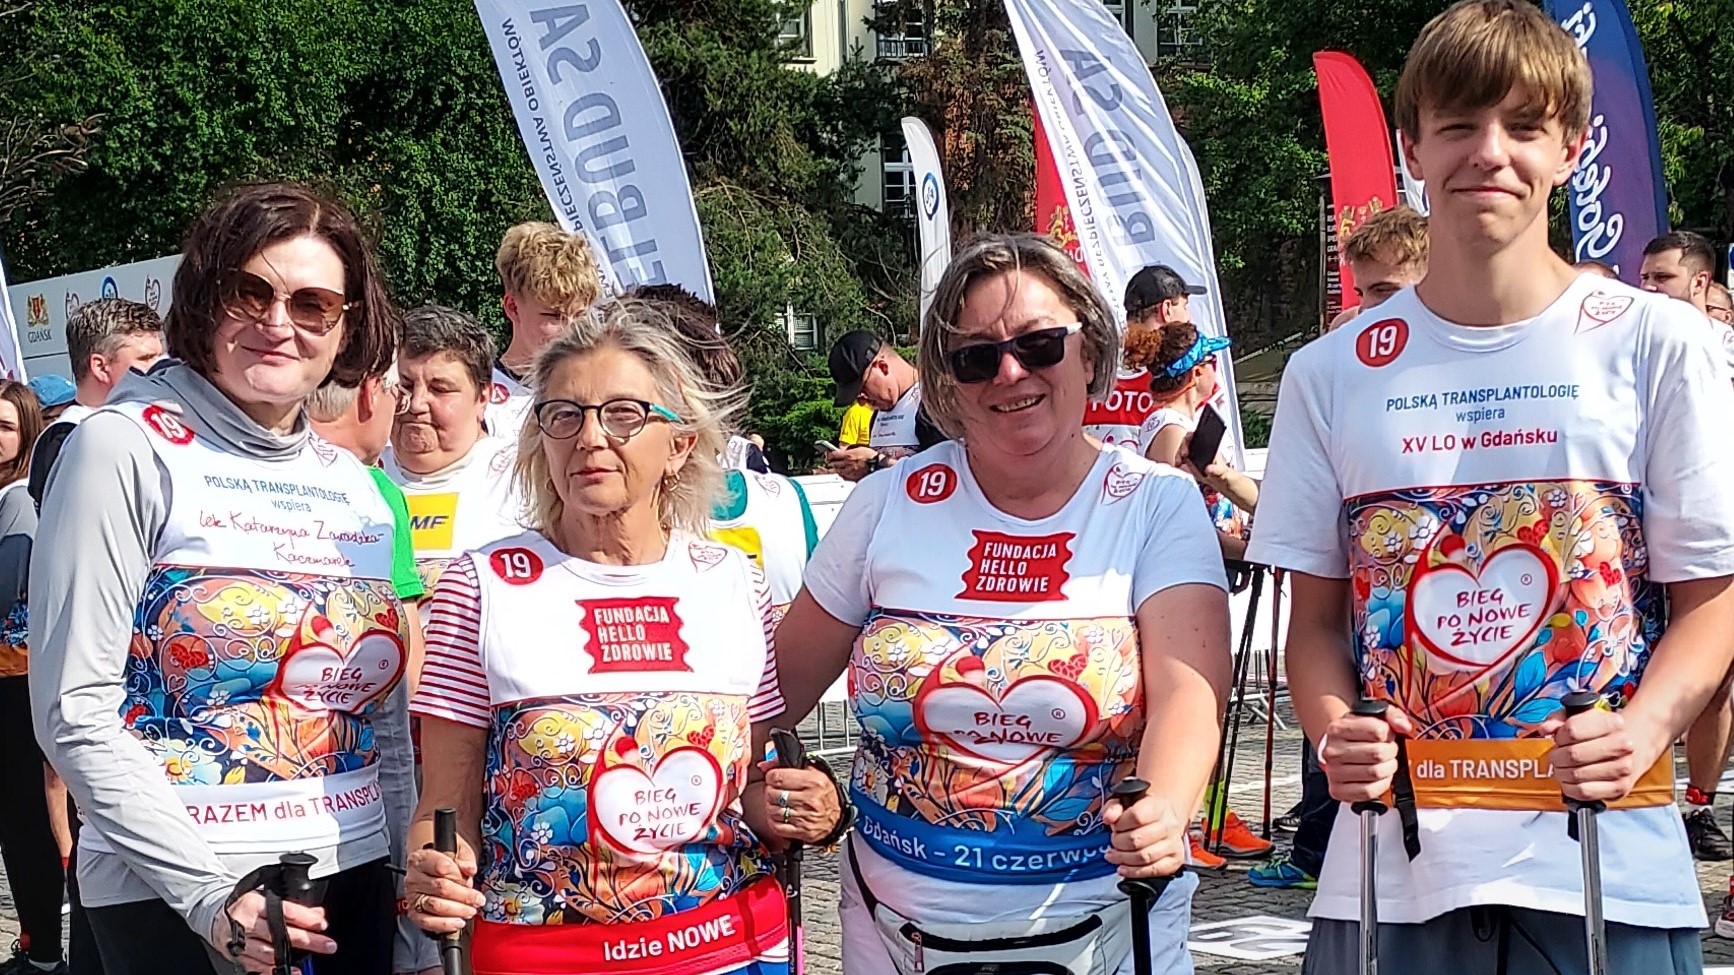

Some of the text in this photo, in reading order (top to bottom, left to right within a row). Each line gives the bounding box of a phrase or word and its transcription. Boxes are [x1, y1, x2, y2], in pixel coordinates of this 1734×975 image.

[1368, 325, 1397, 358] 19
[1386, 384, 1580, 412] POLSKĄ TRANSPLANTOLOGIĘ
[1455, 406, 1506, 424] wspiera
[150, 413, 185, 439] 19
[1402, 429, 1558, 454] XV LO w Gdańsku
[204, 475, 253, 493] POLSKĄ
[918, 471, 946, 497] 19
[271, 499, 312, 513] wspiera
[410, 515, 449, 530] MF
[983, 542, 1057, 559] FUNDACJA
[500, 552, 531, 579] 19
[979, 559, 1027, 575] HELLO
[975, 575, 1049, 593] ZDROWIE
[1456, 588, 1504, 607] BIEG
[593, 605, 669, 625] FUNDACJA
[1437, 603, 1532, 629] PO NOWE
[597, 624, 646, 643] HELLO
[1450, 624, 1514, 646] ŻYCIE
[602, 642, 673, 662] ZDROWIE
[321, 667, 363, 682] BIEG
[303, 688, 354, 704] ŻYCIE
[974, 711, 1032, 730] BIEG
[1416, 759, 1445, 778] dla
[634, 788, 677, 803] BIEG
[186, 803, 267, 825] RAZEM
[274, 801, 306, 819] dla
[647, 802, 702, 823] NOWE
[633, 823, 687, 841] ŻYCIE
[863, 815, 928, 860] Gdańsk
[954, 845, 982, 868] 21
[603, 914, 736, 961] Idzie NOWE
